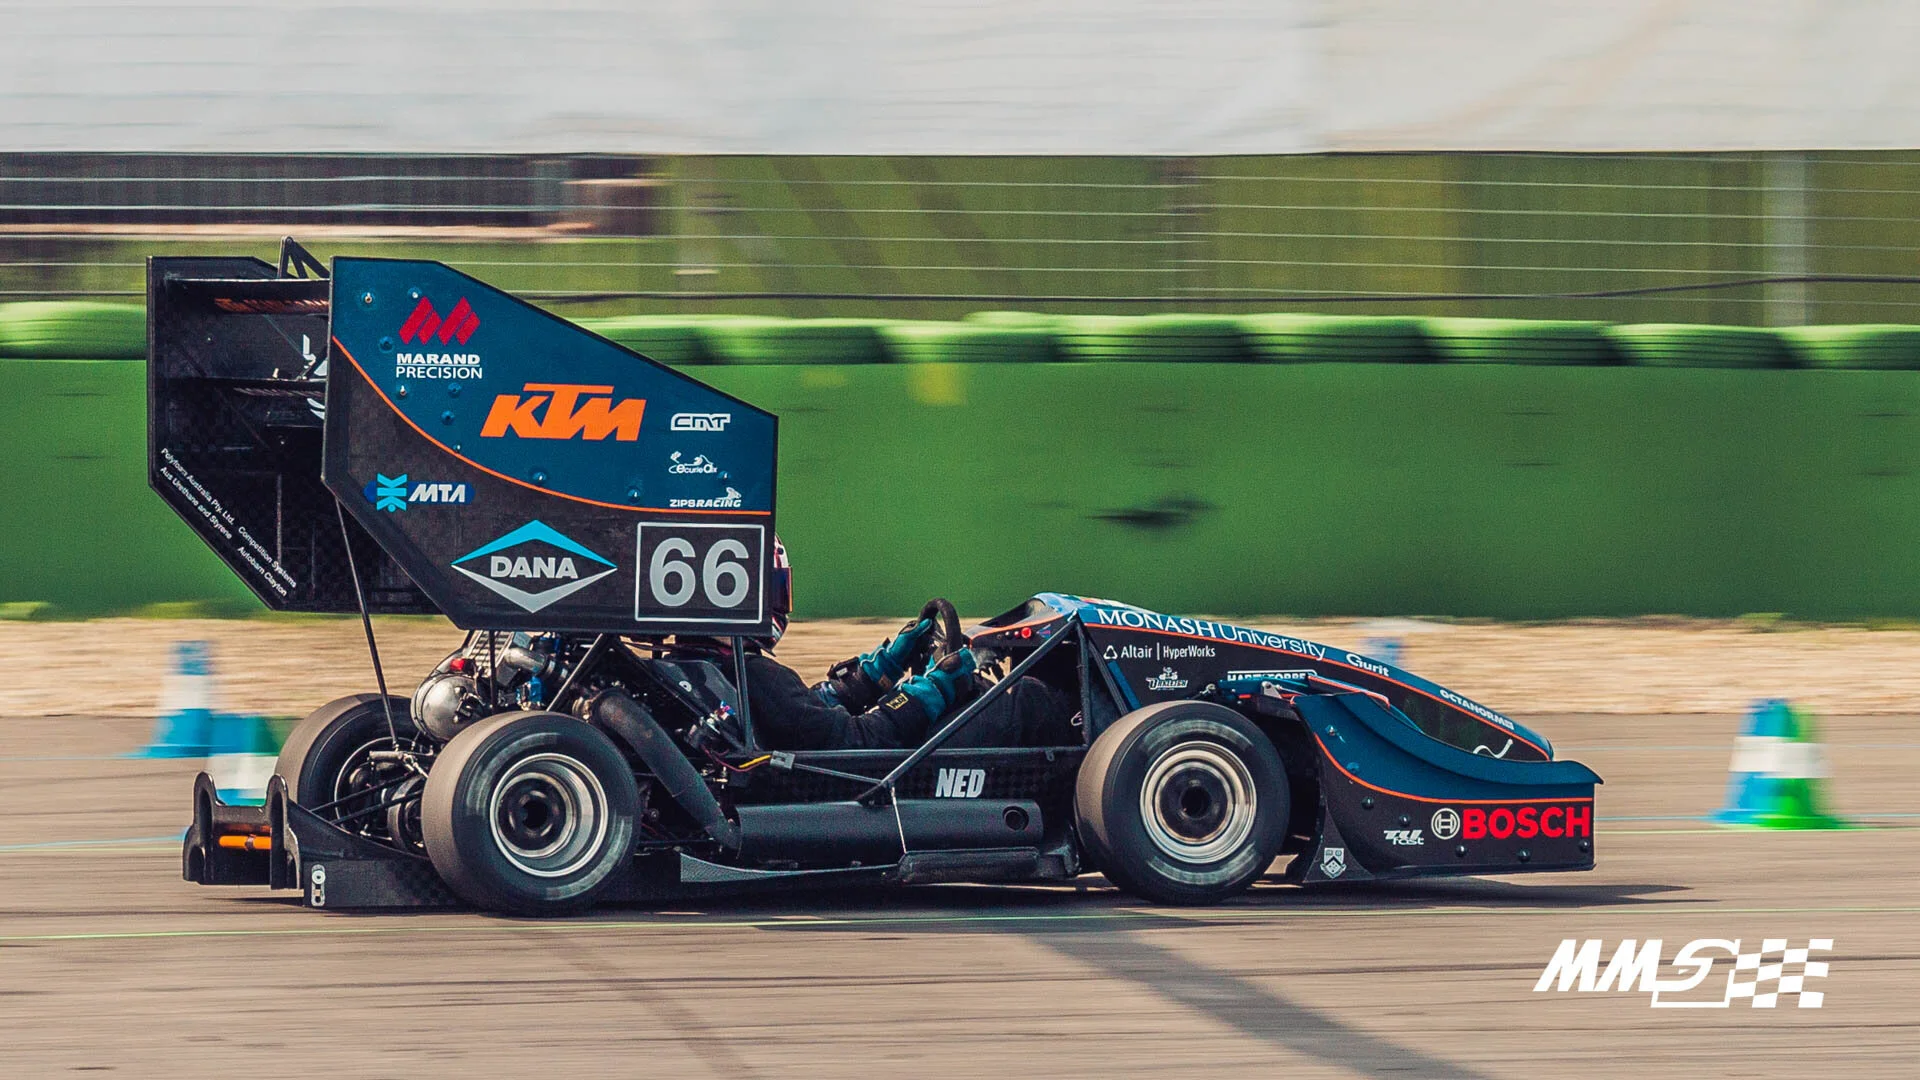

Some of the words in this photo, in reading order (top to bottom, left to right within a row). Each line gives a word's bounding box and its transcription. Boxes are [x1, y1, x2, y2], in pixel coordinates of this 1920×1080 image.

[395, 366, 483, 379] PRECISION
[396, 353, 481, 365] MARAND
[480, 382, 647, 442] KTM
[161, 447, 188, 477] Polyfoam
[186, 475, 213, 502] Australia
[160, 466, 173, 481] Aus
[172, 477, 199, 506] Urethane
[197, 504, 212, 518] and
[209, 515, 233, 540] Styrene
[408, 483, 467, 503] MTA
[238, 526, 273, 564] Competition
[271, 560, 297, 588] Systems
[490, 555, 579, 579] DANA
[649, 536, 750, 608] 66
[264, 571, 288, 597] Clayton
[1097, 608, 1217, 639] MONASH
[1217, 621, 1326, 662] University
[1120, 645, 1153, 659] Altair
[1162, 644, 1216, 660] HyperWorks
[1346, 652, 1390, 678] Gurit
[935, 767, 986, 798] NED
[1462, 806, 1591, 840] BOSCH
